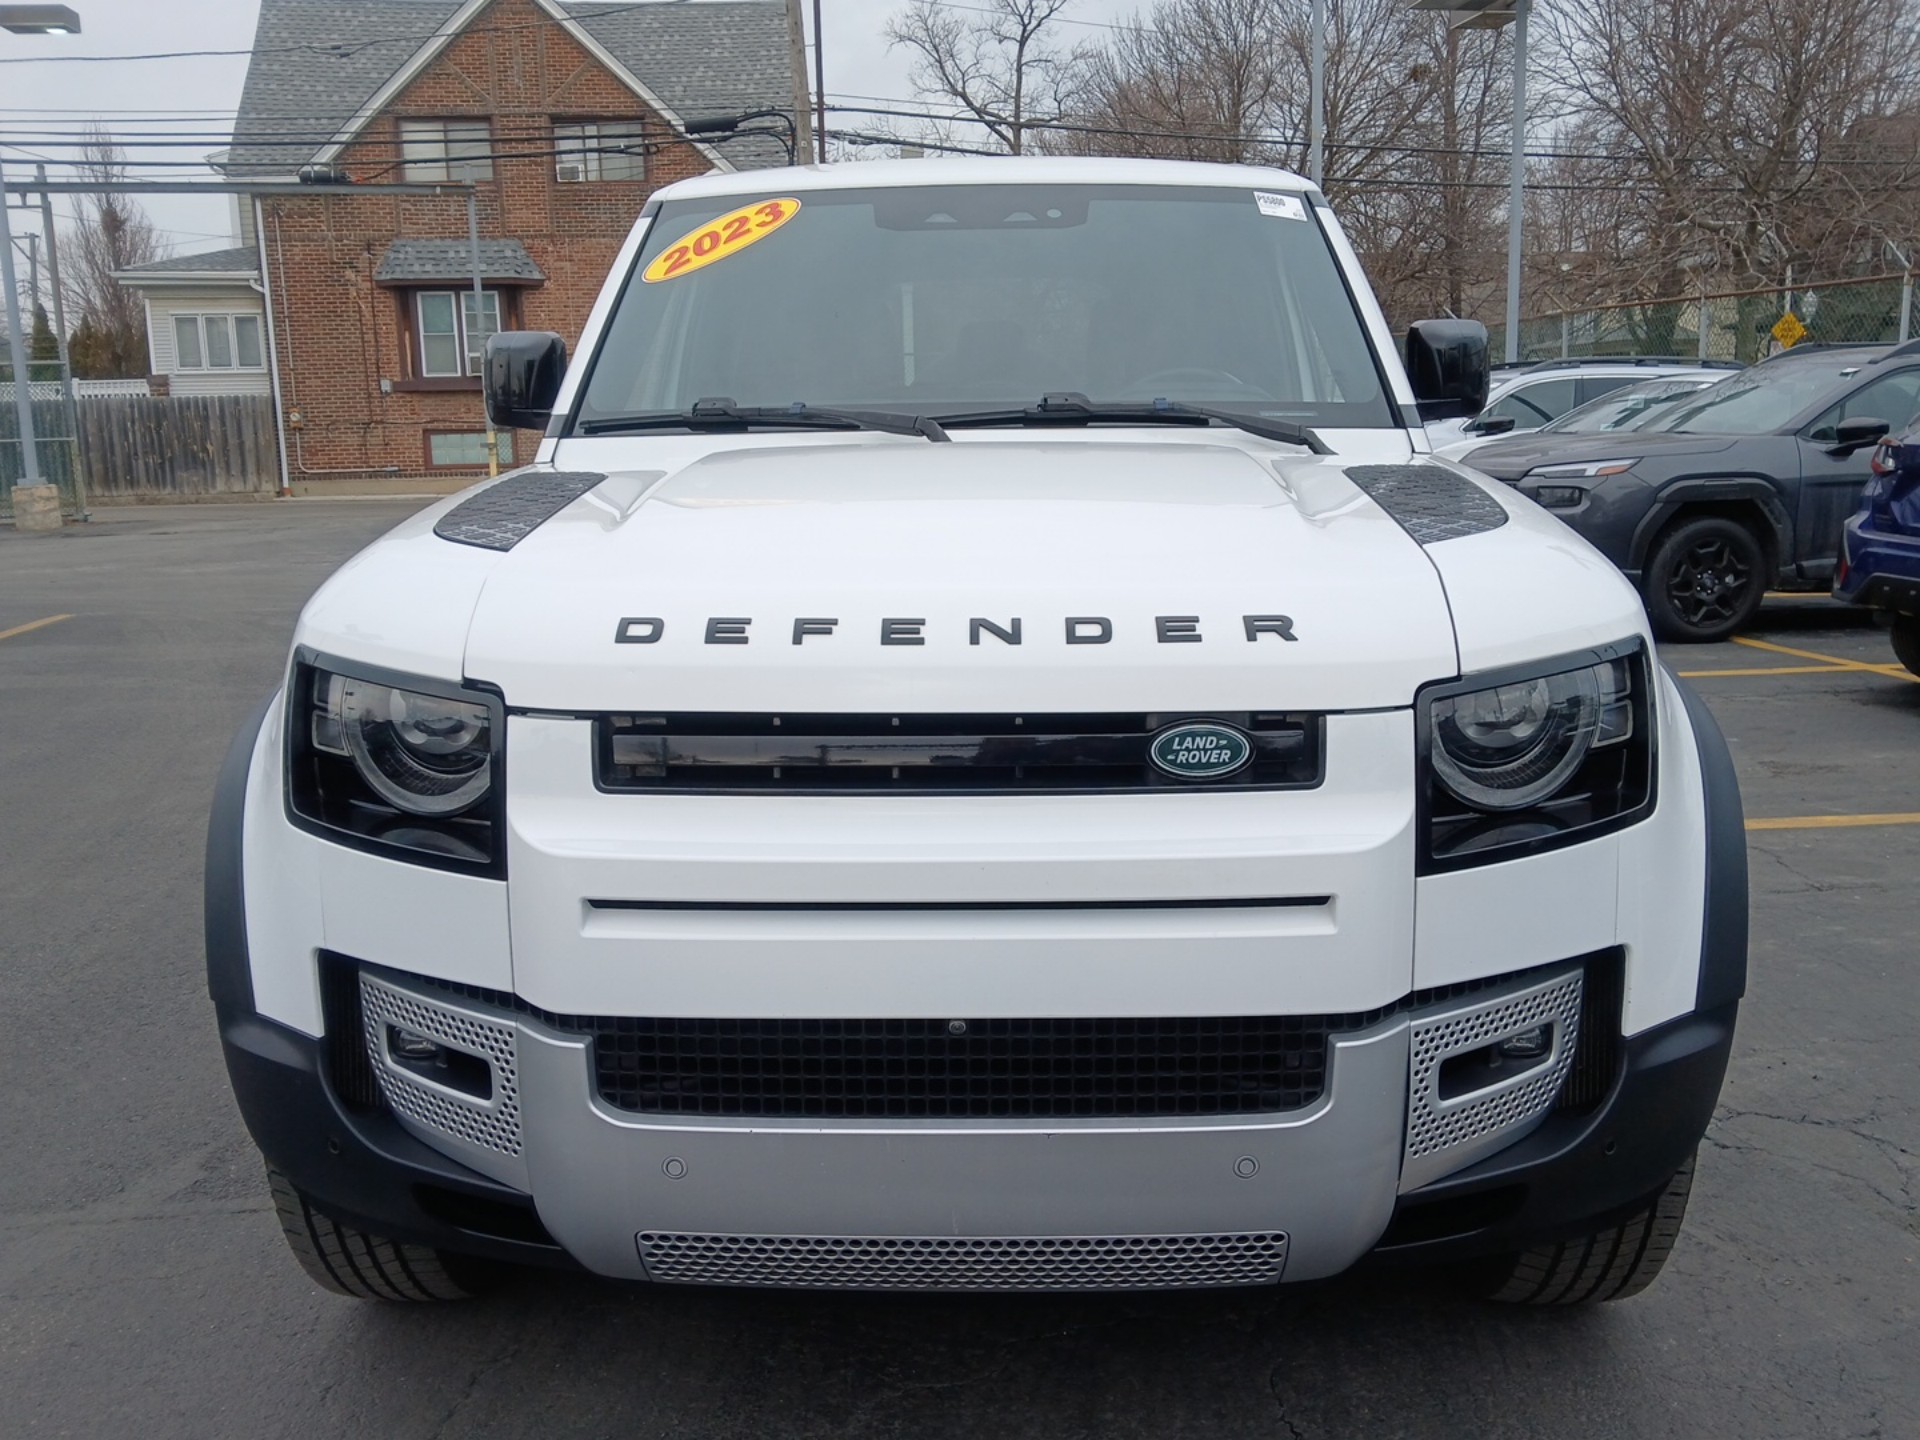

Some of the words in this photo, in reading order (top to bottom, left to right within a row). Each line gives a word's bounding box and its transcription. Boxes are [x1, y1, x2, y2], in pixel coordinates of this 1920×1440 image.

[662, 202, 787, 277] 2023
[614, 614, 1299, 646] DEFENDER
[1172, 736, 1217, 750] LAND
[1176, 750, 1231, 764] ROVER
